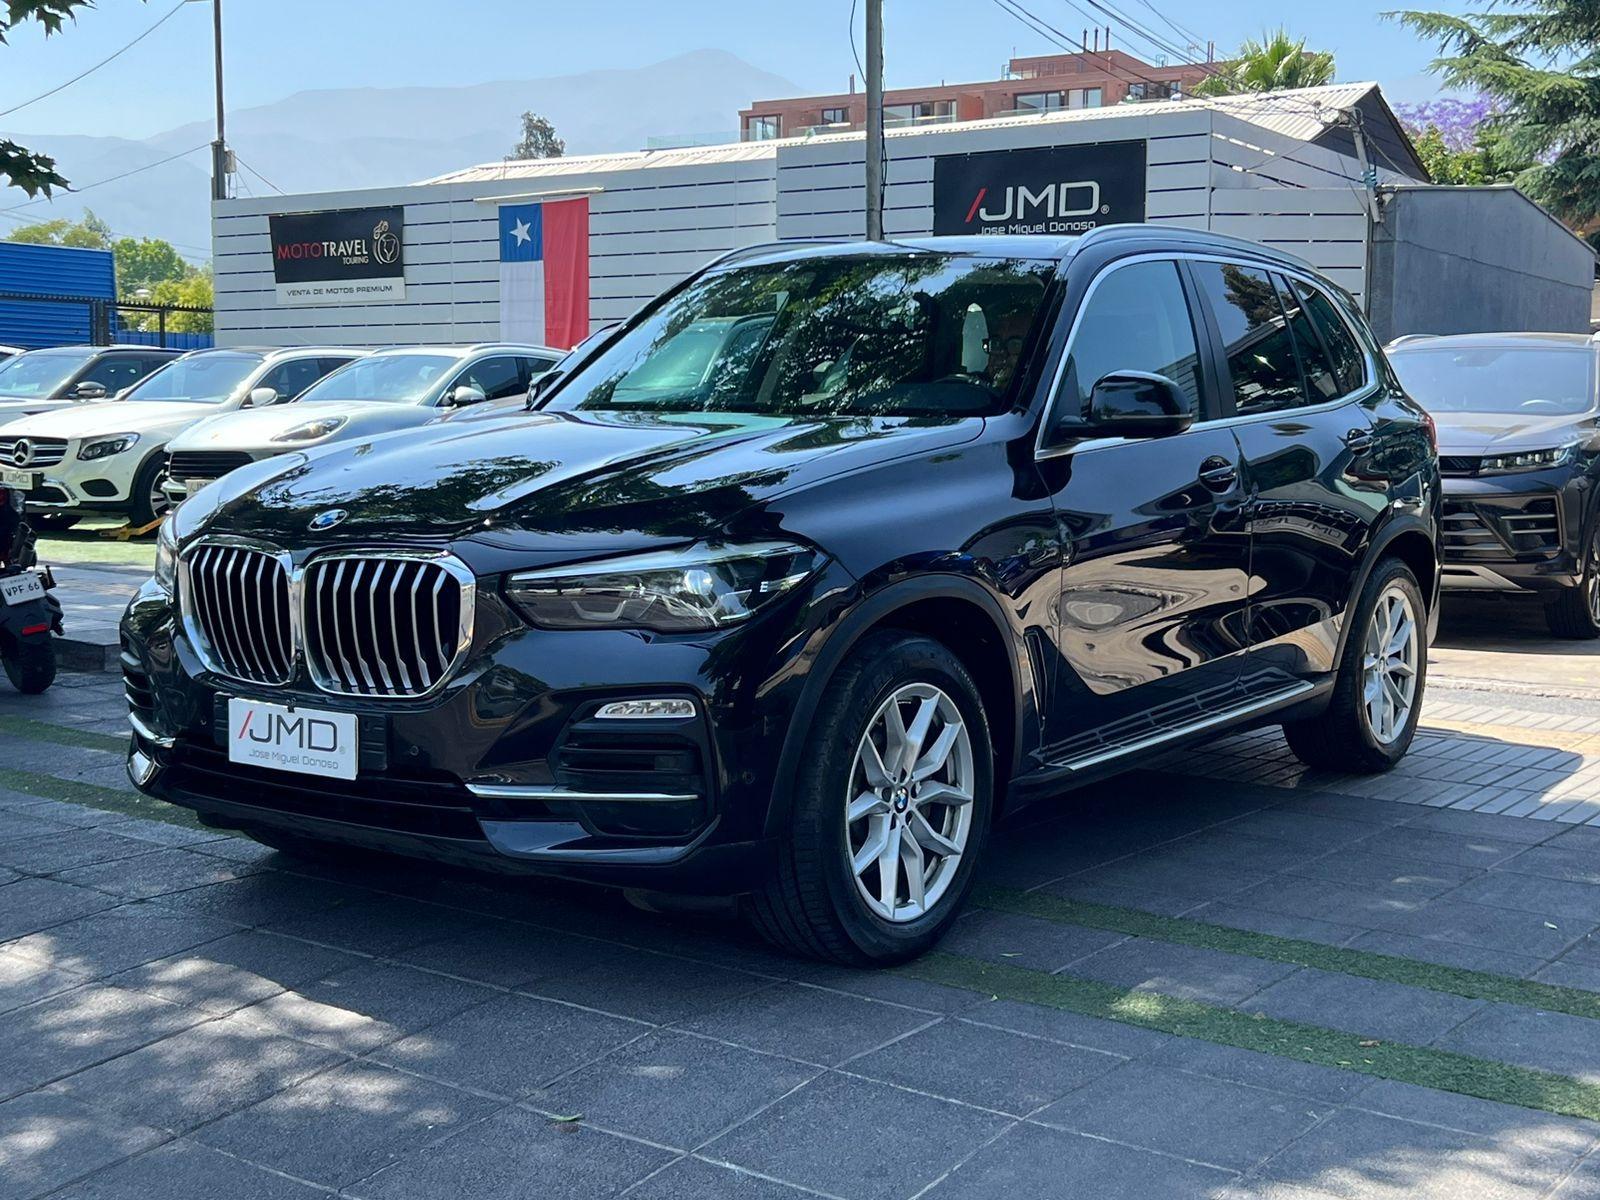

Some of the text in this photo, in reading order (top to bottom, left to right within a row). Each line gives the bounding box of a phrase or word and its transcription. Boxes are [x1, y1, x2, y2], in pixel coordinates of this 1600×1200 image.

[1049, 221, 1096, 232] Donoso
[277, 239, 368, 259] MOTOTRAVEL
[342, 256, 369, 265] TOURING
[287, 289, 311, 297] VENTA
[248, 749, 339, 770] Jose Miguel Donoso
